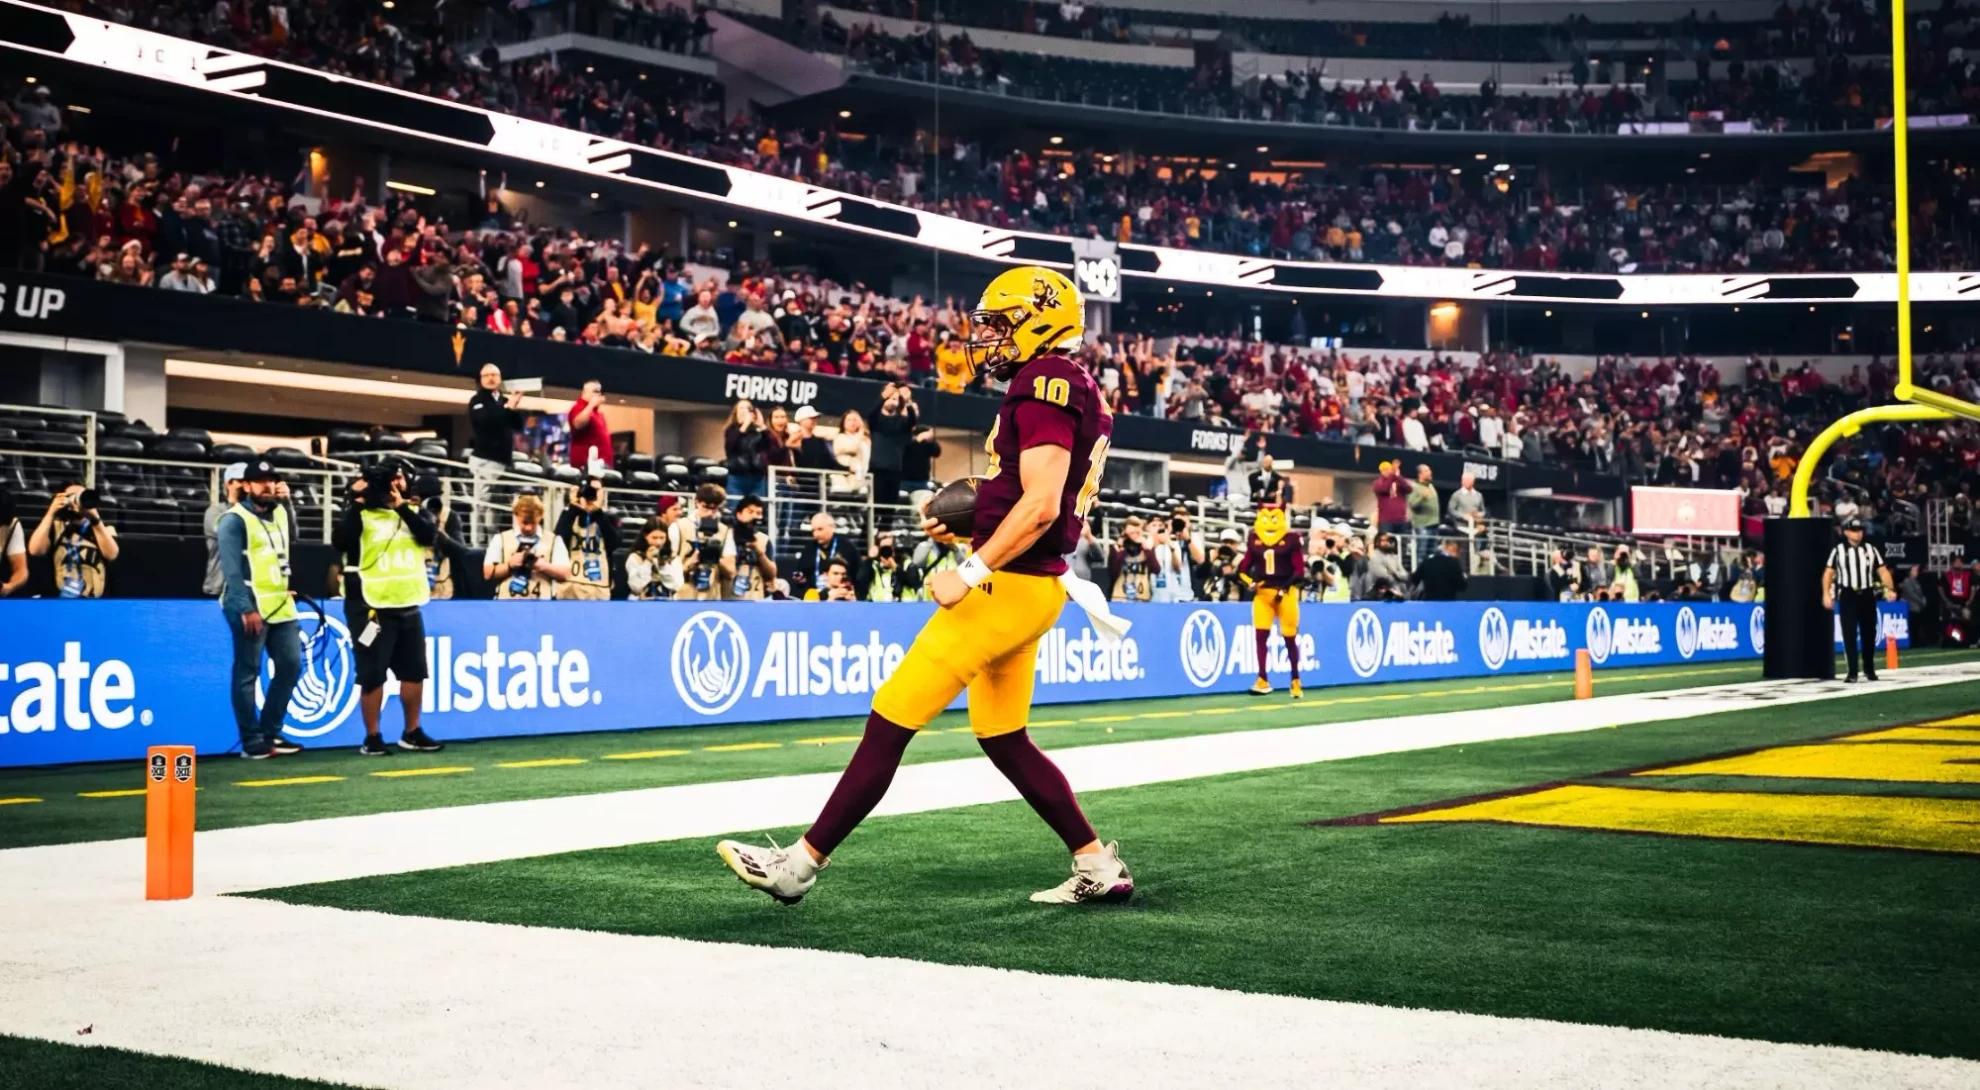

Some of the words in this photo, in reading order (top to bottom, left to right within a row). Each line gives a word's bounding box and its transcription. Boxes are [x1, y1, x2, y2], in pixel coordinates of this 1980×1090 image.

[15, 285, 65, 319] UP
[725, 373, 789, 403] FORKS
[791, 380, 818, 405] UP
[1033, 376, 1070, 407] 10
[1191, 429, 1228, 451] FORKS
[1263, 548, 1275, 575] 1
